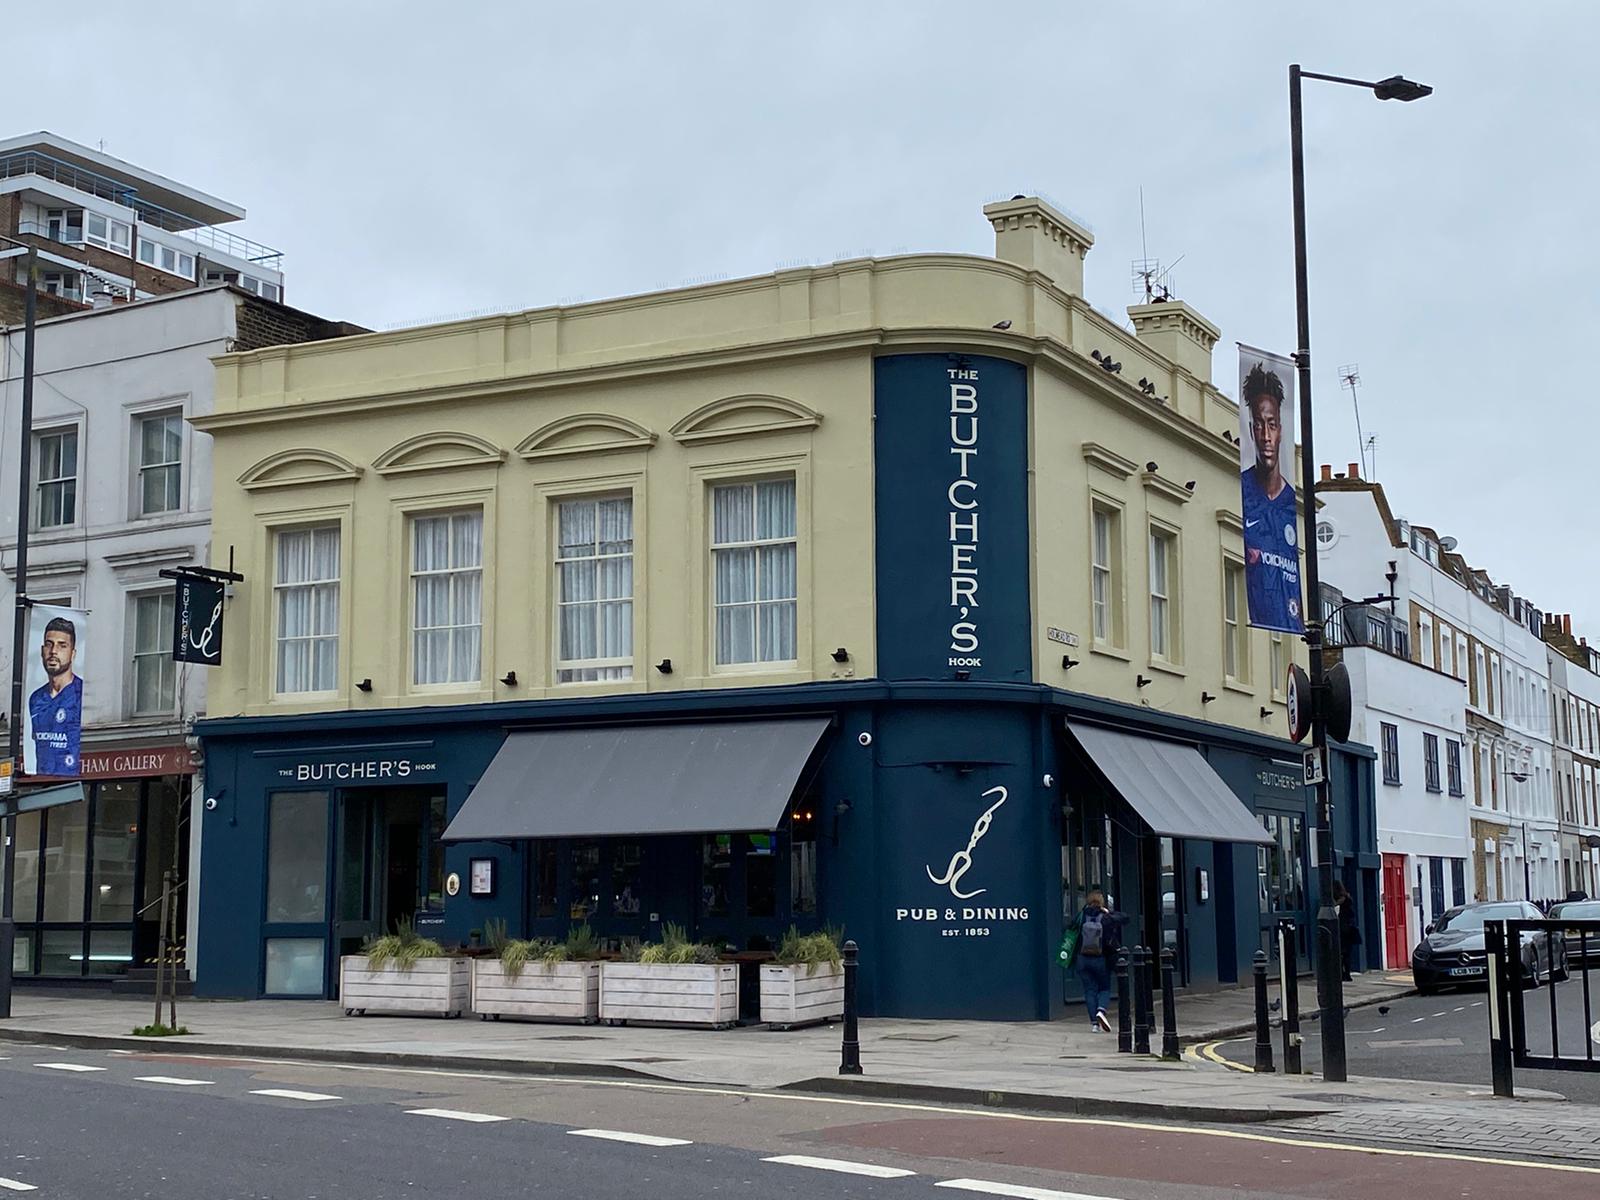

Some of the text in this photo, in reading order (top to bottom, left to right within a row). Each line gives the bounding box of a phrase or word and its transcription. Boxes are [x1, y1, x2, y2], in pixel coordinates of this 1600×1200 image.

[947, 369, 979, 380] THE
[948, 384, 979, 653] BUTCHER'S
[1260, 551, 1297, 573] YOKOHAMA
[949, 658, 981, 667] HOOK
[113, 754, 166, 771] GALLERY
[278, 760, 437, 781] THE BUTCHER'S HOOK
[896, 907, 1029, 921] PUB & DINING
[942, 927, 990, 937] EST. 1853
